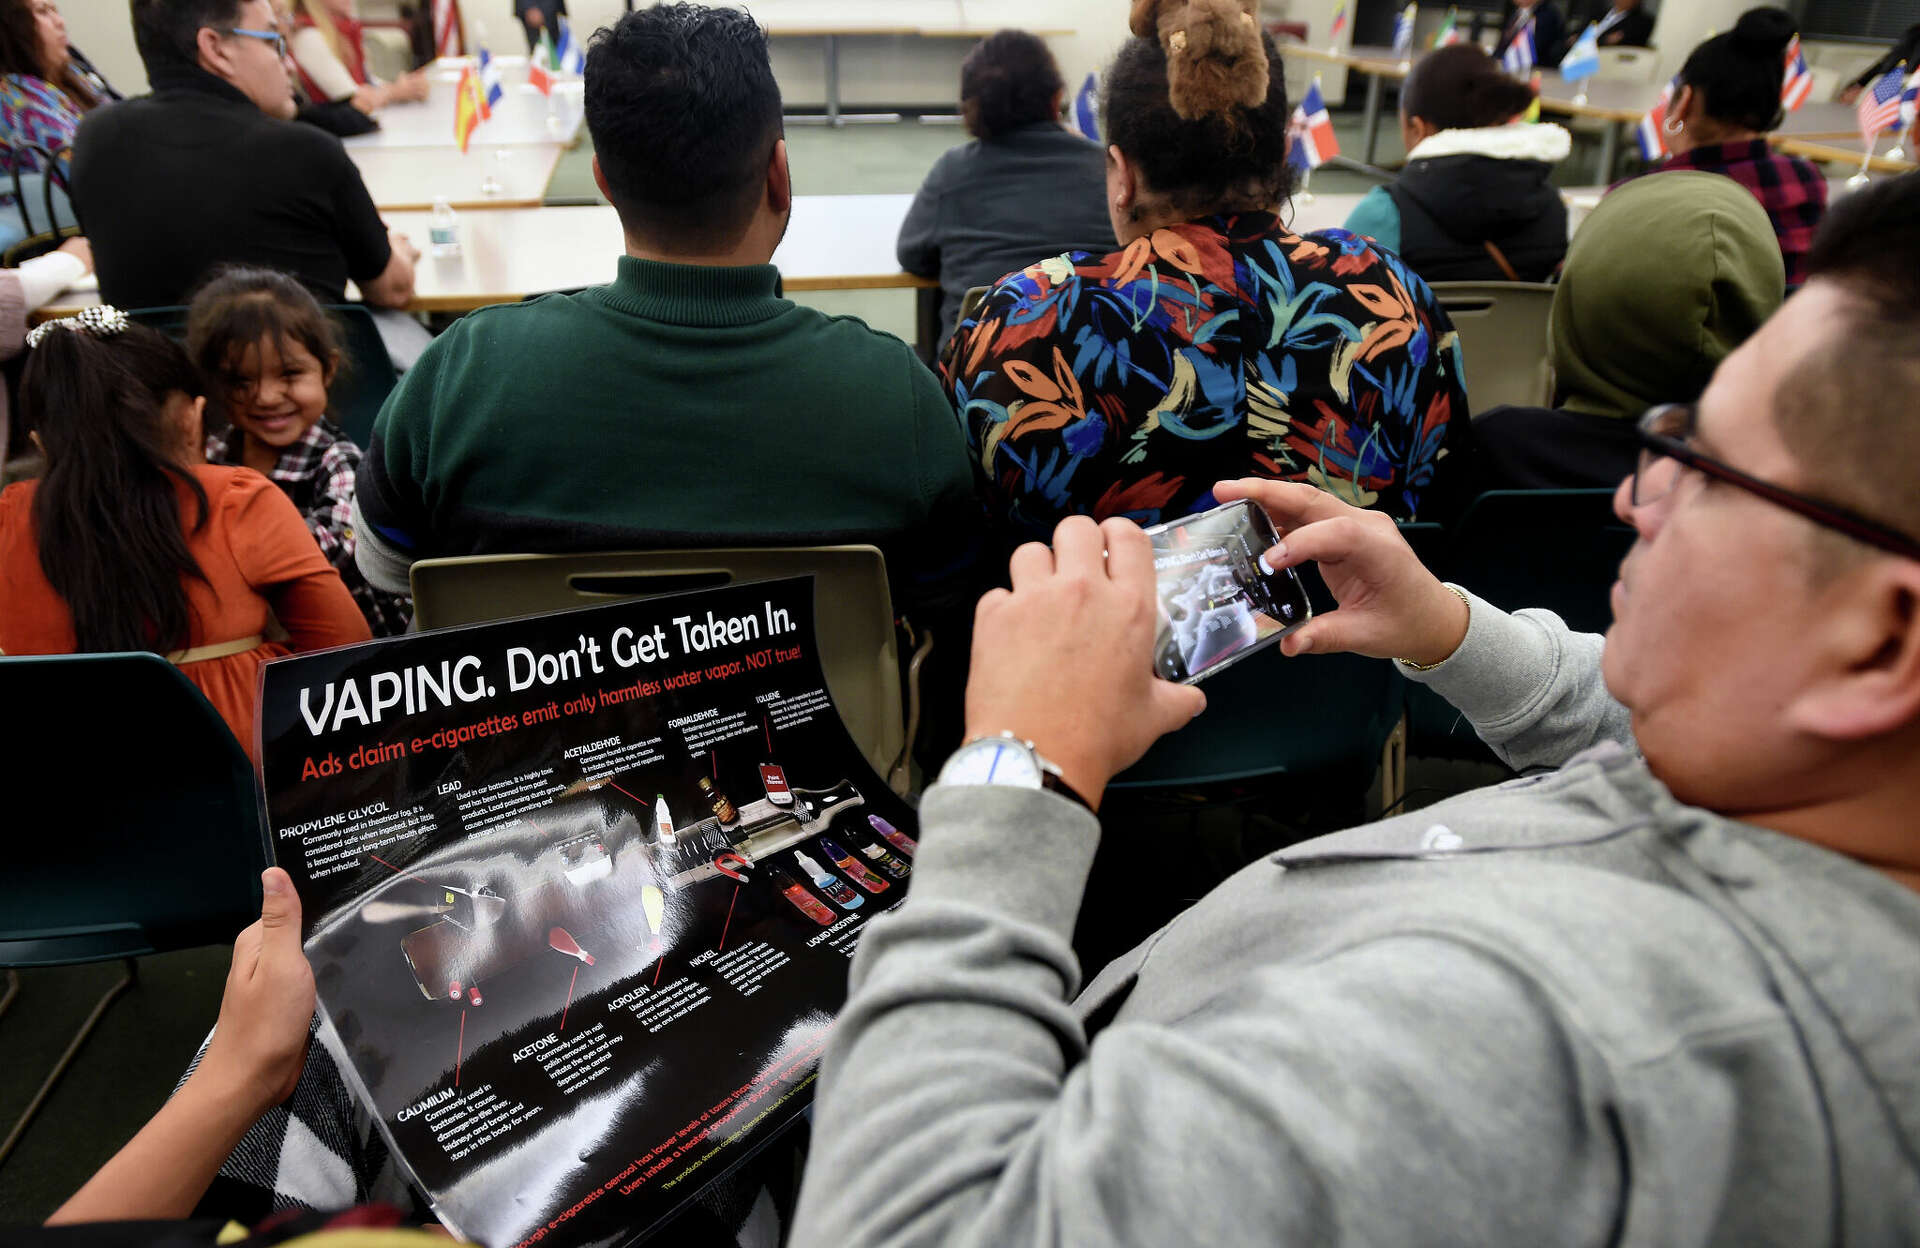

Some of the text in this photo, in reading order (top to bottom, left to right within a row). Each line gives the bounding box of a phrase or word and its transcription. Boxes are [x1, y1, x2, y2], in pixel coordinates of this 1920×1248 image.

[300, 601, 796, 736] VAPING. Don't Get Taken In.
[302, 646, 801, 781] Ads claim e-cigarettes emit only harmless water vapor. NOT true!
[668, 708, 718, 728] FORMALDEHYDE
[565, 736, 621, 759] ACETALDEHYDE
[437, 781, 461, 795] LEAD
[456, 791, 471, 800] Used
[524, 771, 540, 780] highly
[459, 801, 471, 810] and
[482, 795, 497, 803] been
[497, 787, 519, 798] banned
[533, 779, 548, 789] paint
[280, 802, 389, 839] PROPYLENE GLYCOL
[465, 797, 553, 830] causes nausea and vomiting and
[488, 802, 504, 812] Lead
[303, 829, 341, 845] Commonly
[343, 823, 359, 834] used
[368, 811, 399, 826] theatrical
[305, 839, 343, 856] considered
[344, 836, 358, 845] safe
[359, 831, 378, 840] when
[408, 818, 420, 826] but
[420, 813, 434, 822] little
[314, 854, 339, 866] known
[340, 847, 362, 858] about
[362, 837, 396, 851] long-term
[396, 829, 417, 840] health
[310, 858, 360, 879] when inhaled.
[806, 931, 831, 947] LIQUID
[828, 913, 860, 933] NICOTINE
[690, 950, 718, 967] NICKEL
[608, 985, 650, 1012] ACROLEIN
[629, 1000, 644, 1011] Used
[672, 989, 683, 998] and
[650, 1024, 662, 1032] eyes
[662, 1016, 674, 1025] and
[513, 1033, 558, 1063] ACETONE
[536, 1042, 570, 1061] Commonly
[570, 1032, 585, 1044] used
[592, 1022, 603, 1032] nail
[544, 1058, 562, 1071] polish
[562, 1043, 589, 1060] remover.
[595, 1033, 606, 1042] can
[549, 1035, 623, 1079] irritate the eyes and may
[557, 1052, 612, 1087] depress the central
[564, 1067, 610, 1095] nervous system.
[397, 1088, 455, 1121] CADMIUM
[425, 1098, 466, 1121] Commonly
[467, 1087, 484, 1100] used
[430, 1111, 468, 1132] batteries.
[475, 1094, 497, 1109] causes
[437, 1100, 511, 1142] damage to the liver,
[442, 1103, 524, 1152] kidneys and brain and
[451, 1148, 470, 1161] stays
[478, 1135, 492, 1145] the
[491, 1124, 511, 1137] body
[511, 1117, 522, 1125] for
[523, 1106, 543, 1120] years.
[549, 1189, 603, 1228] e-cigarette
[605, 1164, 637, 1189] aerosol
[635, 1154, 653, 1166] has
[651, 1136, 677, 1154] lower
[676, 1120, 701, 1137] levels
[700, 1112, 710, 1121] of
[709, 1098, 733, 1114] toxins
[732, 1083, 750, 1098] than
[619, 1177, 646, 1195] Users
[644, 1157, 673, 1178] inhale
[679, 1128, 709, 1152] heated
